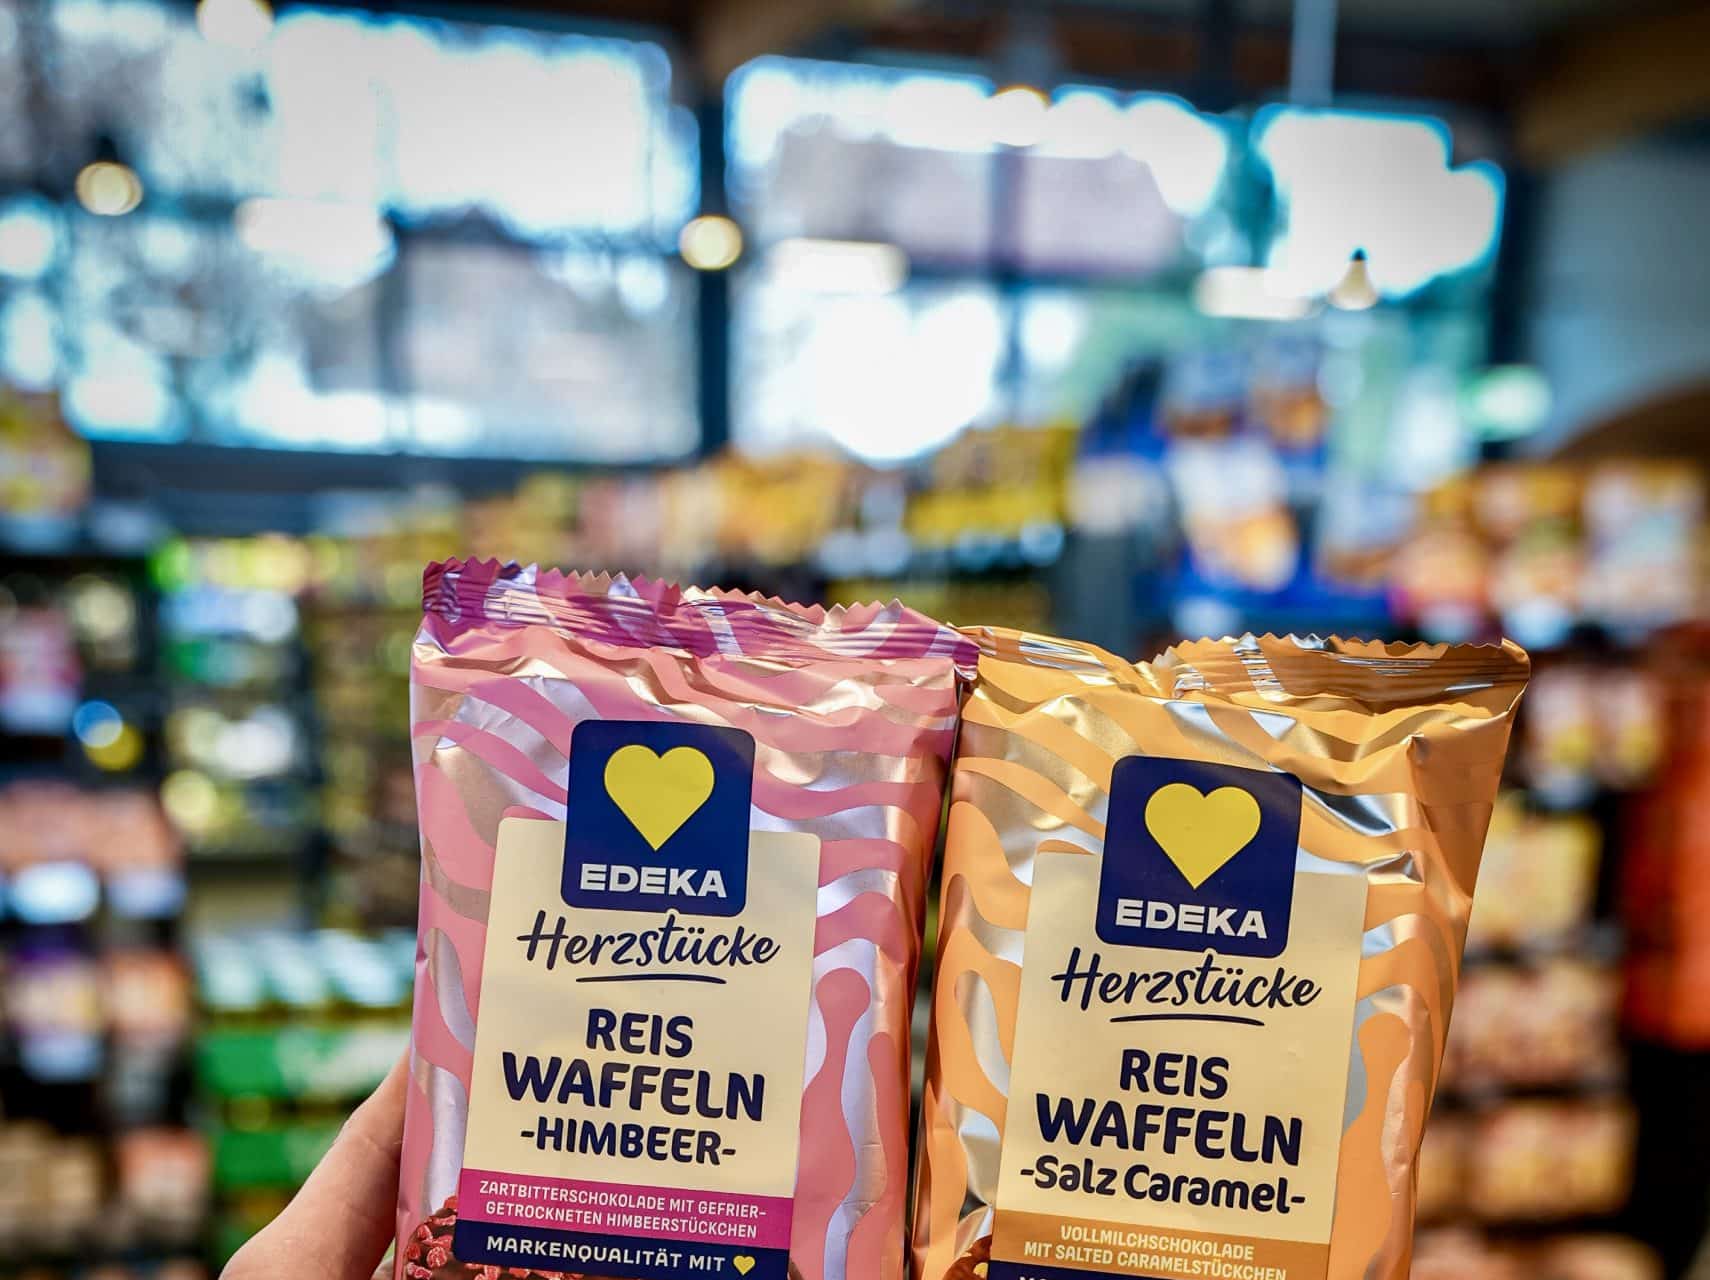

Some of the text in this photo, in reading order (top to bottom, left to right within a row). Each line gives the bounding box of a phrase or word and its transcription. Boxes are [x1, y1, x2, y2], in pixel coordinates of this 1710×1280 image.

[579, 862, 727, 899] EDEKA
[516, 909, 781, 971] Herzstücke
[1114, 898, 1268, 940] EDEKA
[1050, 946, 1322, 1011] Herzstücke
[585, 1007, 694, 1058] REIS
[501, 1051, 766, 1122] WAFFELN
[1118, 1048, 1231, 1100] REIS
[520, 1115, 737, 1167] -HIMBEER-
[1035, 1092, 1303, 1167] WAFFELN
[479, 1180, 767, 1219] ZARTBITTERSCHOKOLADE MIT GEFRIER-
[1020, 1154, 1306, 1215] -Salz Caramel-
[485, 1201, 757, 1239] GETROCKNETEN HIMBEERSTÜCKCHEN
[1060, 1225, 1255, 1261] VOLLMILCHSCHOKOLADE
[486, 1235, 726, 1272] MARKENQUALITÄT MIT
[1024, 1241, 1052, 1258] MIT
[1055, 1243, 1113, 1265] SALTED
